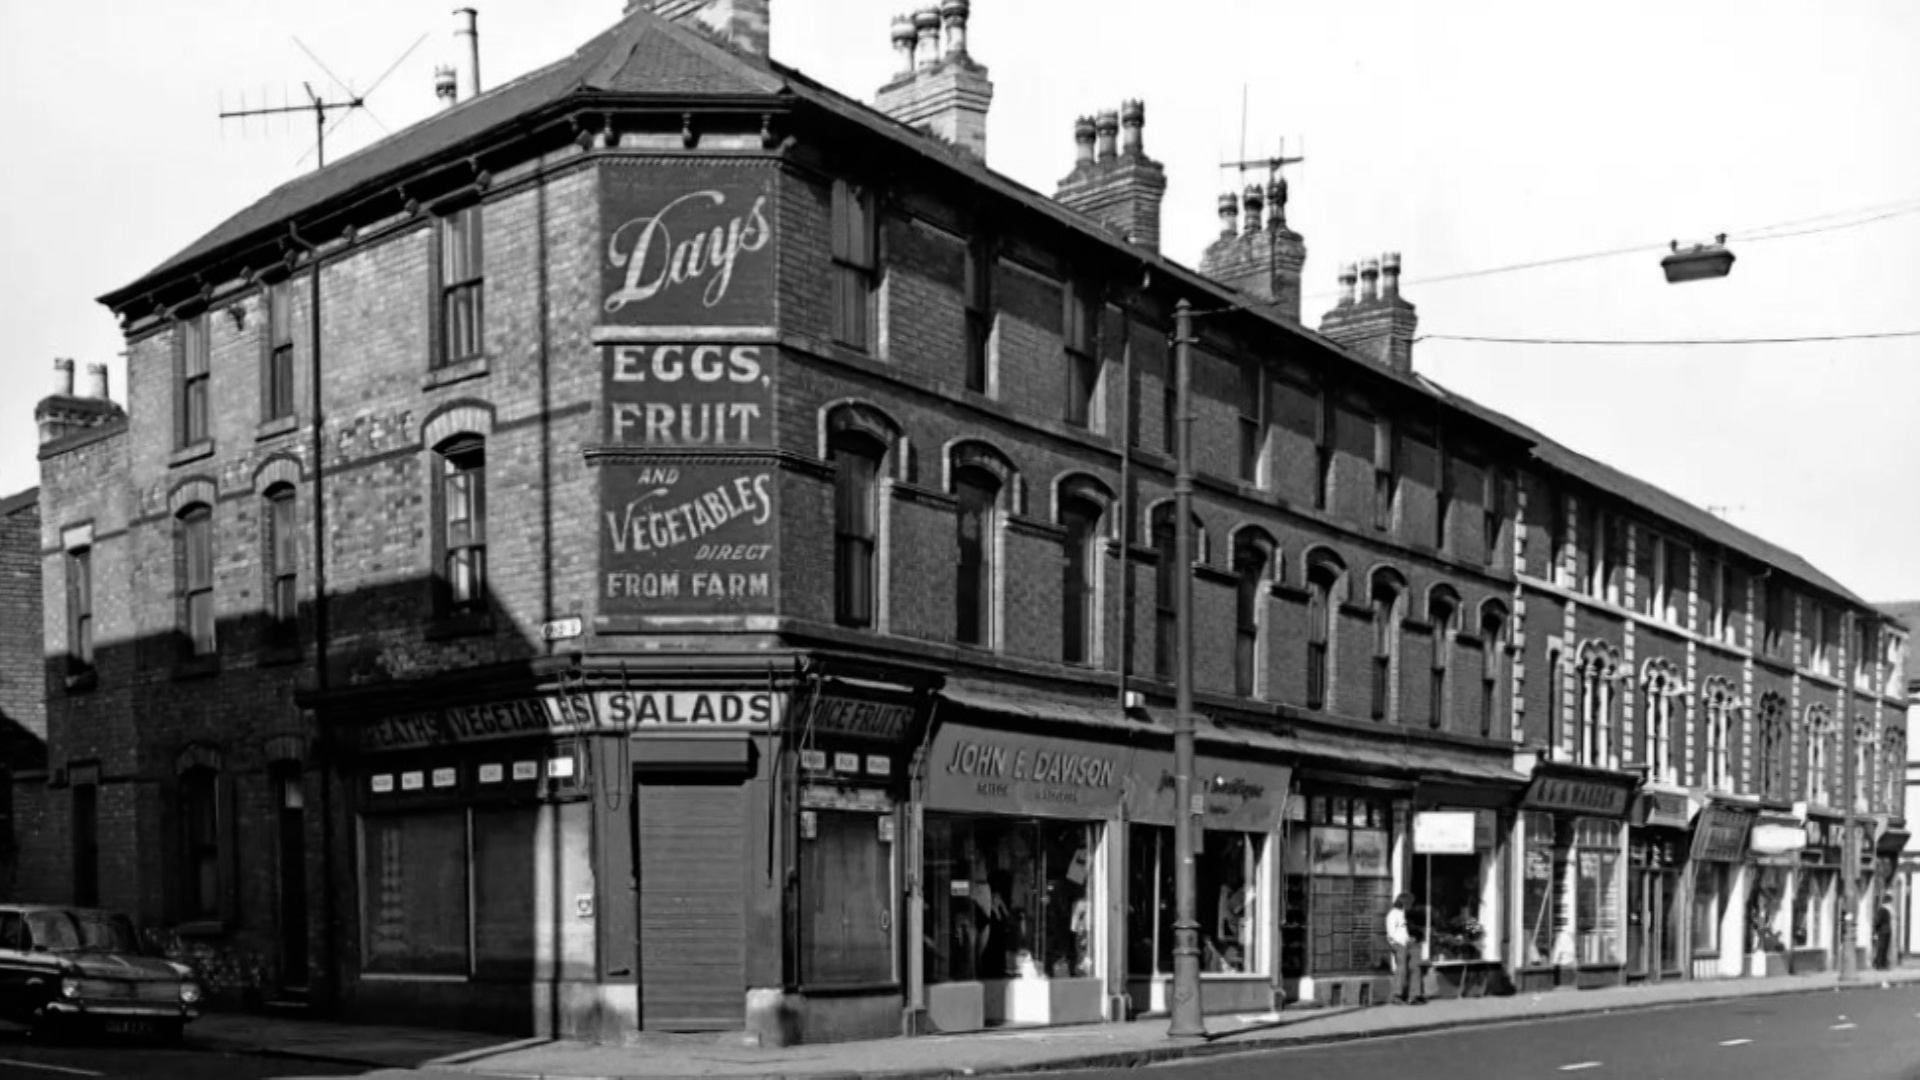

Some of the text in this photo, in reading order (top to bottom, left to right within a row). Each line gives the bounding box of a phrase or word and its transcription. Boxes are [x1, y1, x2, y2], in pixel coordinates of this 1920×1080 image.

[604, 189, 770, 313] Days
[613, 345, 770, 388] EGGS,
[612, 402, 761, 444] FRUIT
[637, 467, 681, 485] AND
[694, 545, 773, 561] DIRECT
[607, 573, 768, 598] FROM FARM
[609, 693, 772, 724] SALADS
[946, 741, 1007, 778] JOHN
[1032, 749, 1117, 789] DAVISON
